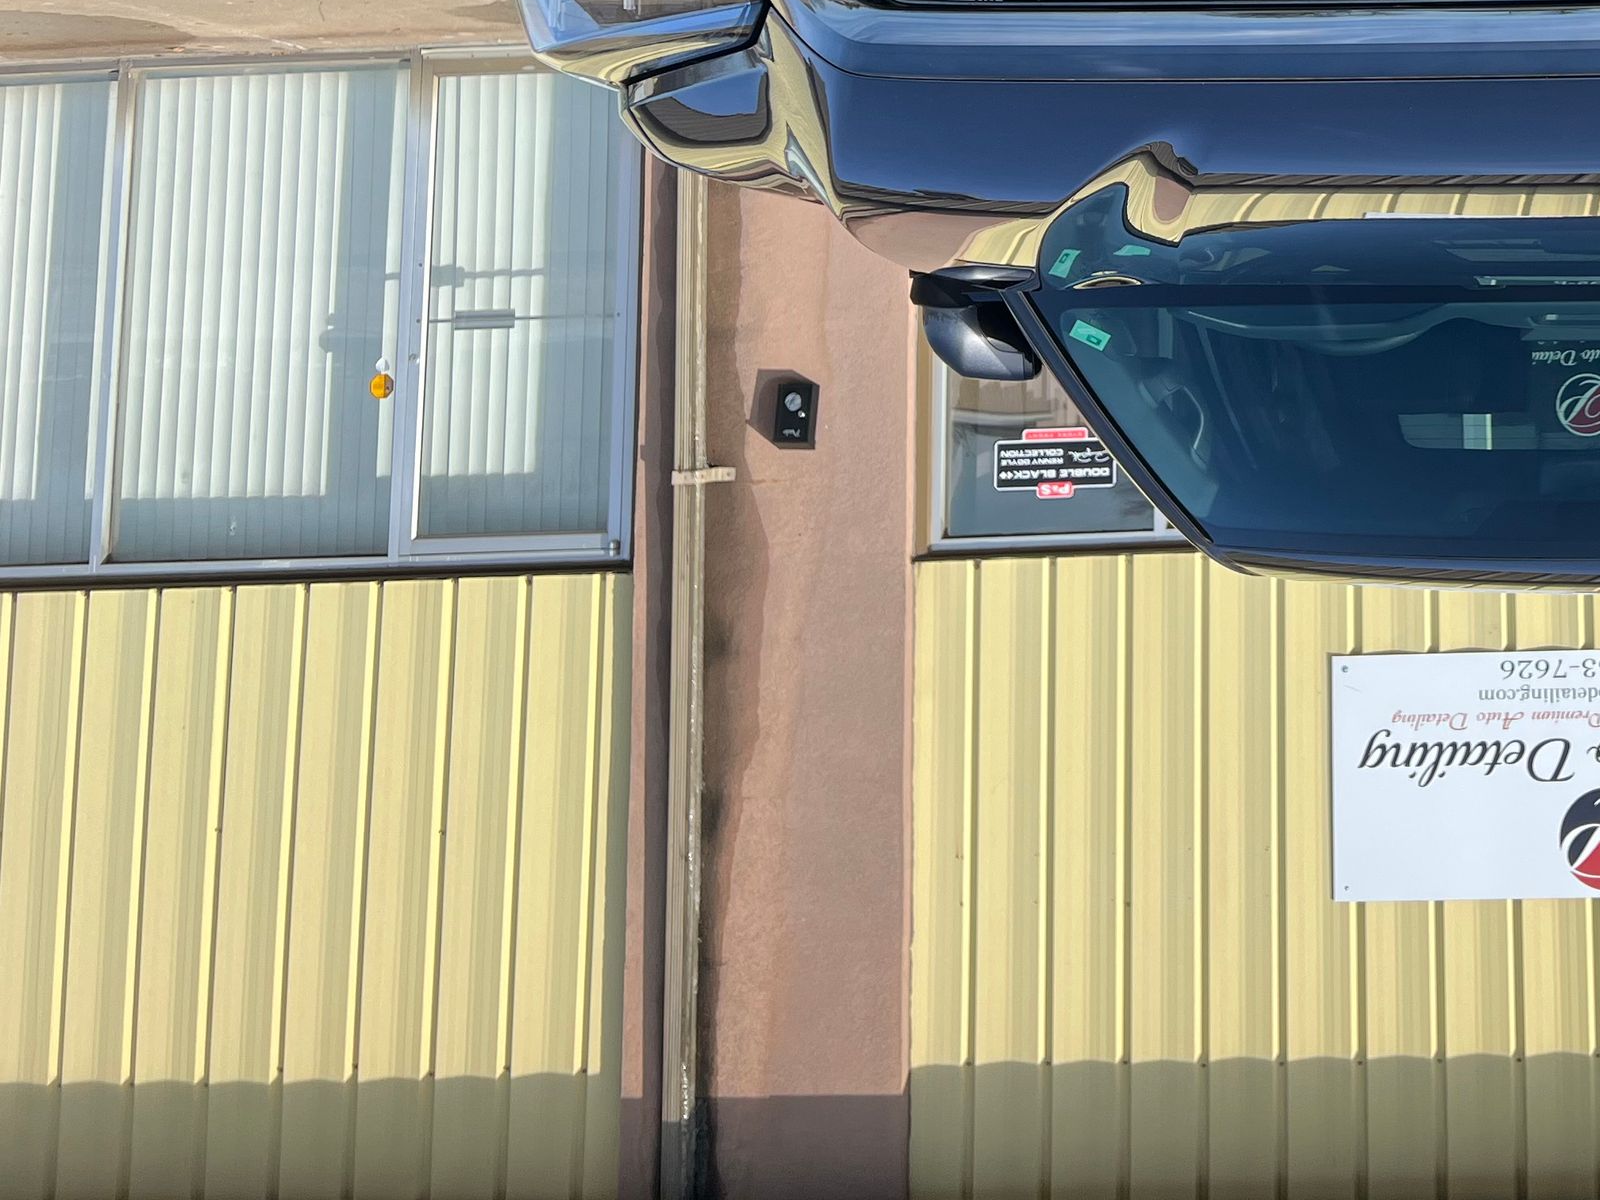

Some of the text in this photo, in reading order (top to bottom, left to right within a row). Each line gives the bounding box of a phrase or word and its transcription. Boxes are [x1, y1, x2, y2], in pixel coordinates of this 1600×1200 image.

[1001, 448, 1064, 457] COLLECTION
[1013, 467, 1110, 479] DOUBLE BLACK
[1040, 483, 1070, 494] P&S
[1391, 710, 1468, 731] Detailing
[1476, 710, 1524, 730] Auto
[1357, 729, 1575, 787] Detailing
